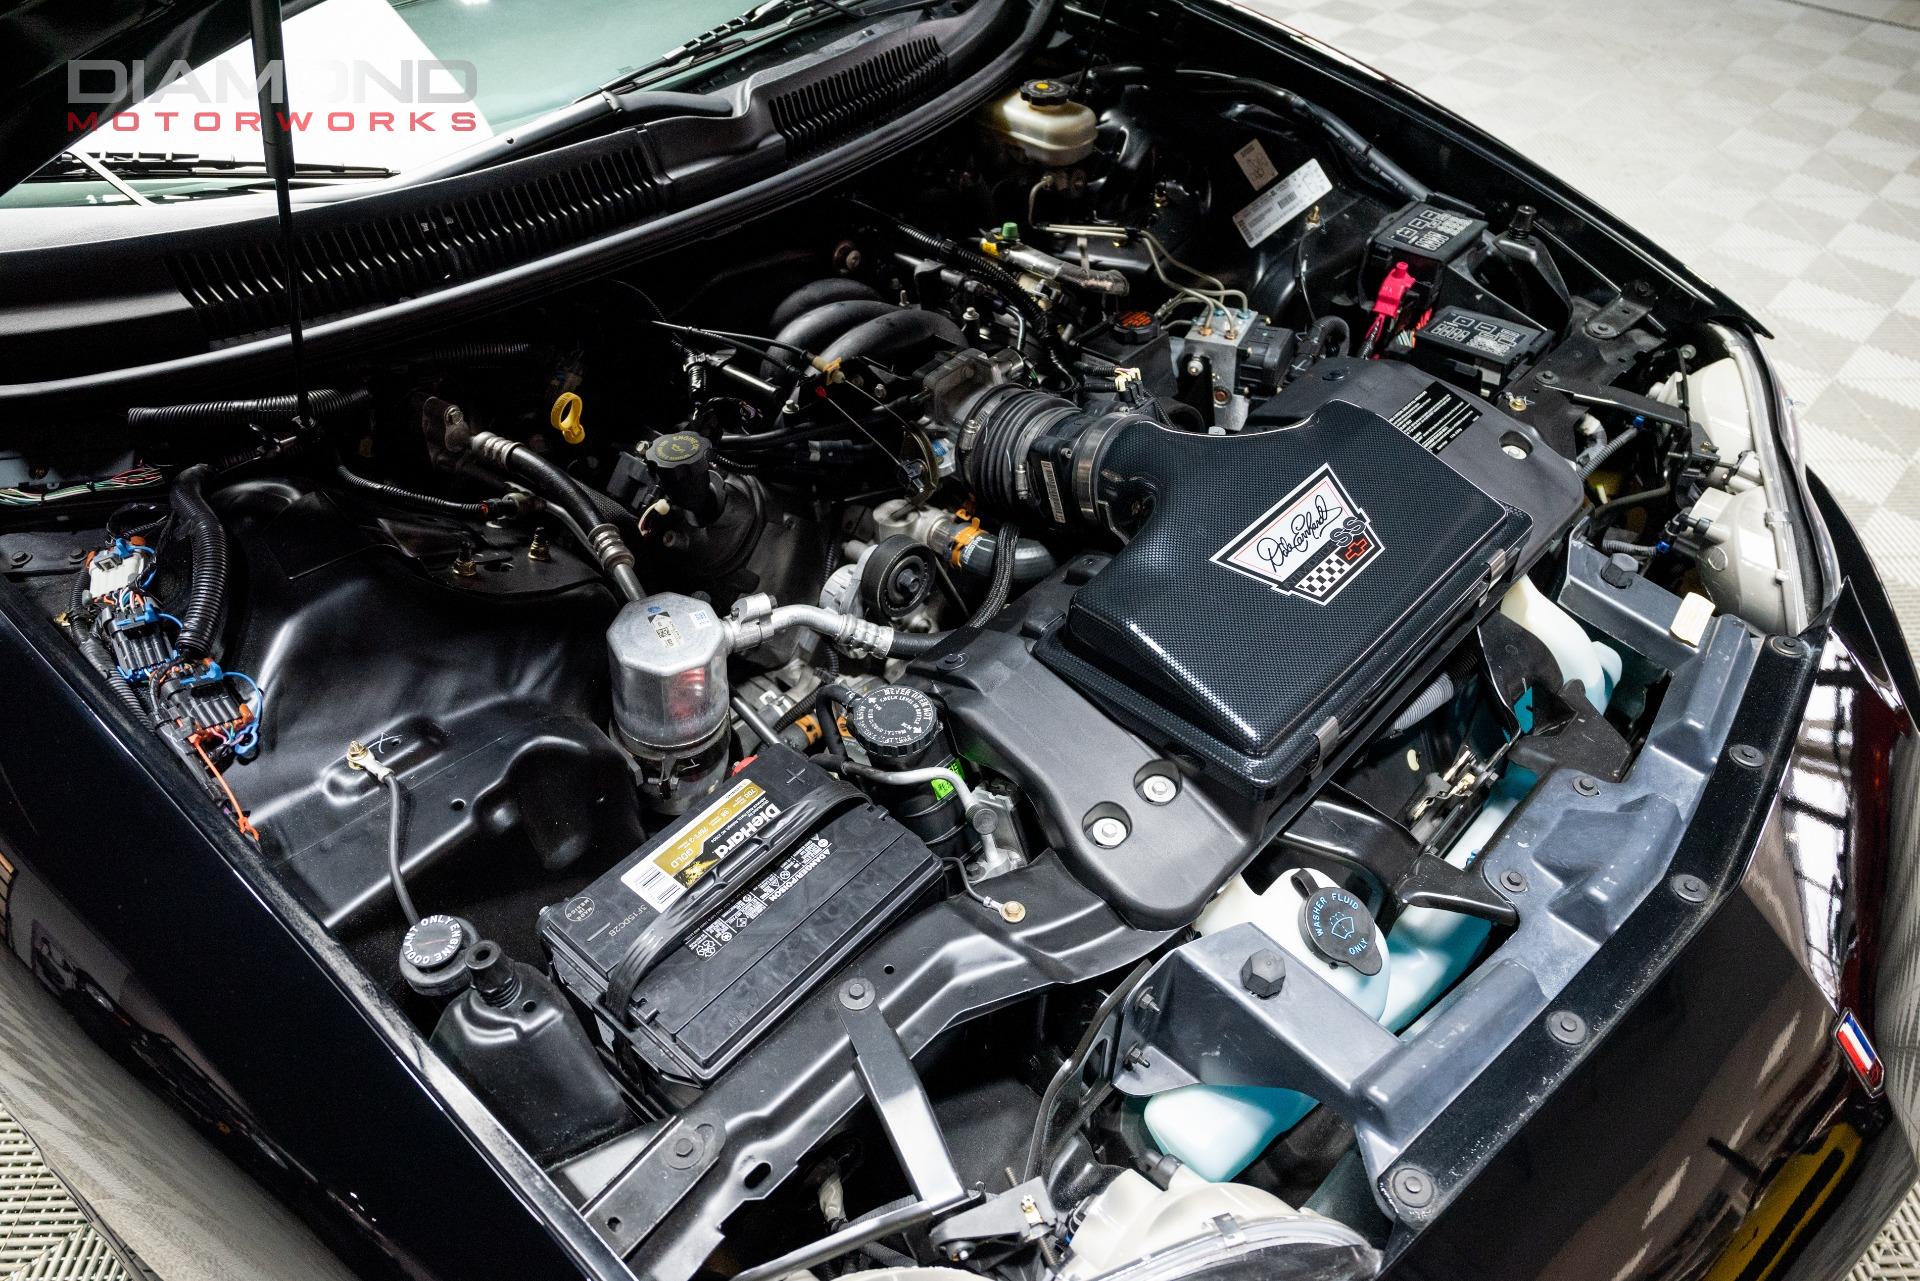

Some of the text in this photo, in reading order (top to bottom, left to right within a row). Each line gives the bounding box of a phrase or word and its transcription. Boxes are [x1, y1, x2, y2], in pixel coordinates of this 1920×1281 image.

[1329, 516, 1366, 547] SS
[922, 706, 931, 721] HOT
[713, 802, 780, 858] DieHard
[670, 847, 694, 868] GOLD
[768, 852, 826, 901] DANGER/POISON
[567, 899, 589, 917] MEXICO
[576, 907, 592, 920] MADE
[403, 915, 462, 964] ENGINE COOLANT ONLY
[1312, 893, 1368, 955] WASHER FLUID ONLY
